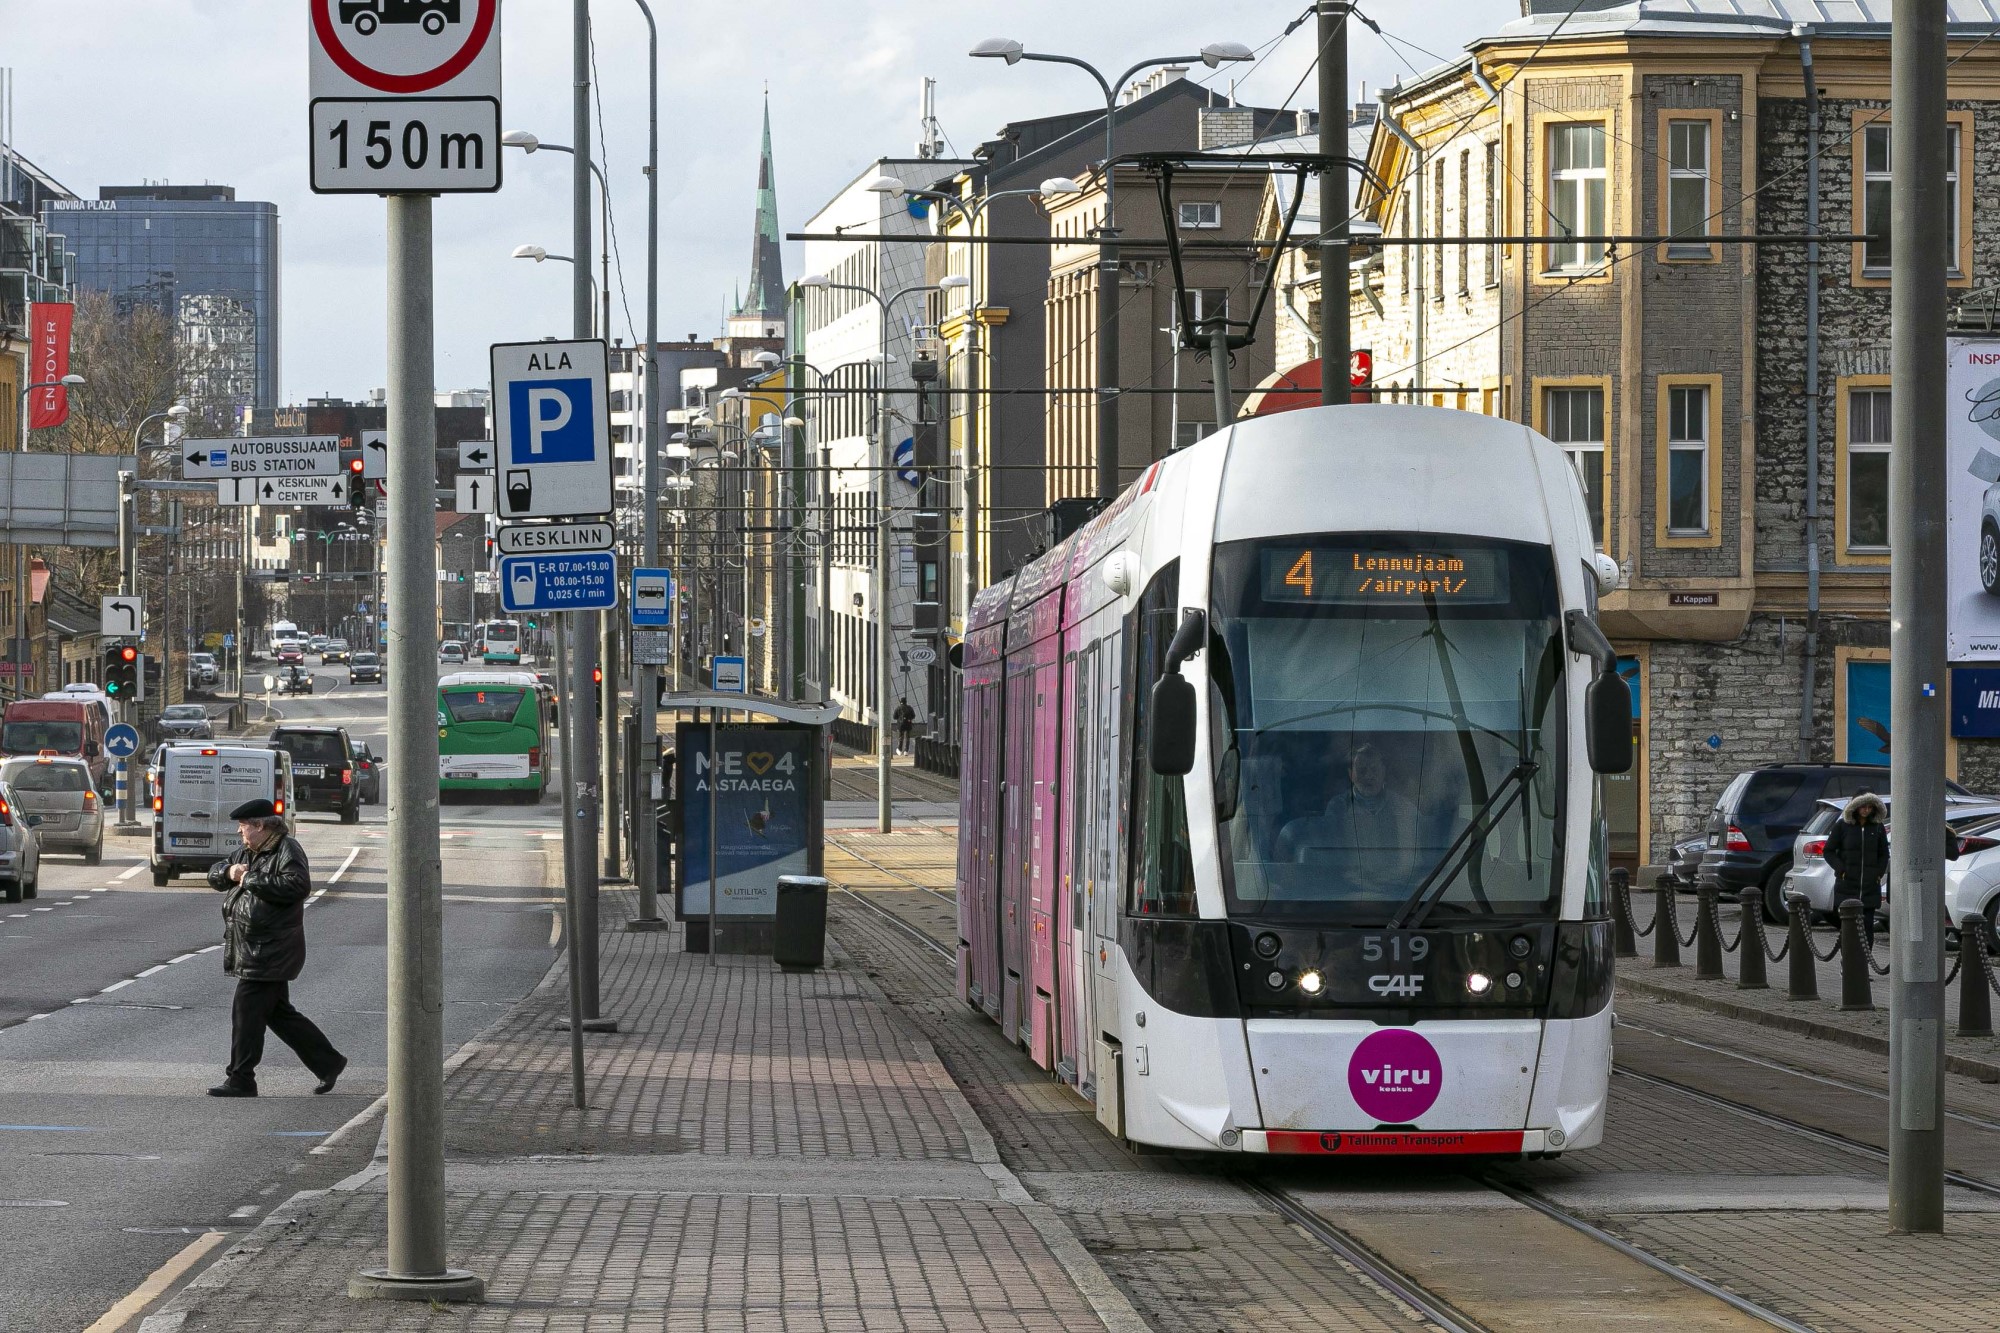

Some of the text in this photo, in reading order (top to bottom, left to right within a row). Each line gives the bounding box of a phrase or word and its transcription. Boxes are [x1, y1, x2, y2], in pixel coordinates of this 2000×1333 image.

[53, 200, 117, 211] NOVIRA PLAZA
[45, 321, 57, 411] ENDOVER
[527, 352, 573, 371] ALA
[528, 387, 572, 454] P
[230, 440, 337, 456] AUTOBUSSIJAAM
[231, 458, 316, 472] BUS STATION
[278, 477, 328, 488] KESKLINN
[278, 491, 318, 502] CENTER
[511, 528, 602, 547] KESKLINN
[538, 561, 610, 574] E-R 07.00-19.00
[1285, 550, 1464, 596] 4 Lennujaam
[545, 575, 605, 587] L 08.00-15.00
[1358, 576, 1467, 594] /airport/
[548, 588, 573, 600] 0,025
[588, 588, 605, 598] min
[1674, 595, 1683, 603] J.
[775, 751, 796, 775] 4
[695, 779, 796, 792] AASTAAEGA
[733, 888, 768, 896] UTILITAS
[1363, 935, 1430, 961] 519
[1368, 974, 1425, 997] CAF
[1360, 1064, 1430, 1085] viru
[1346, 1134, 1465, 1148] Tallinna Transport
